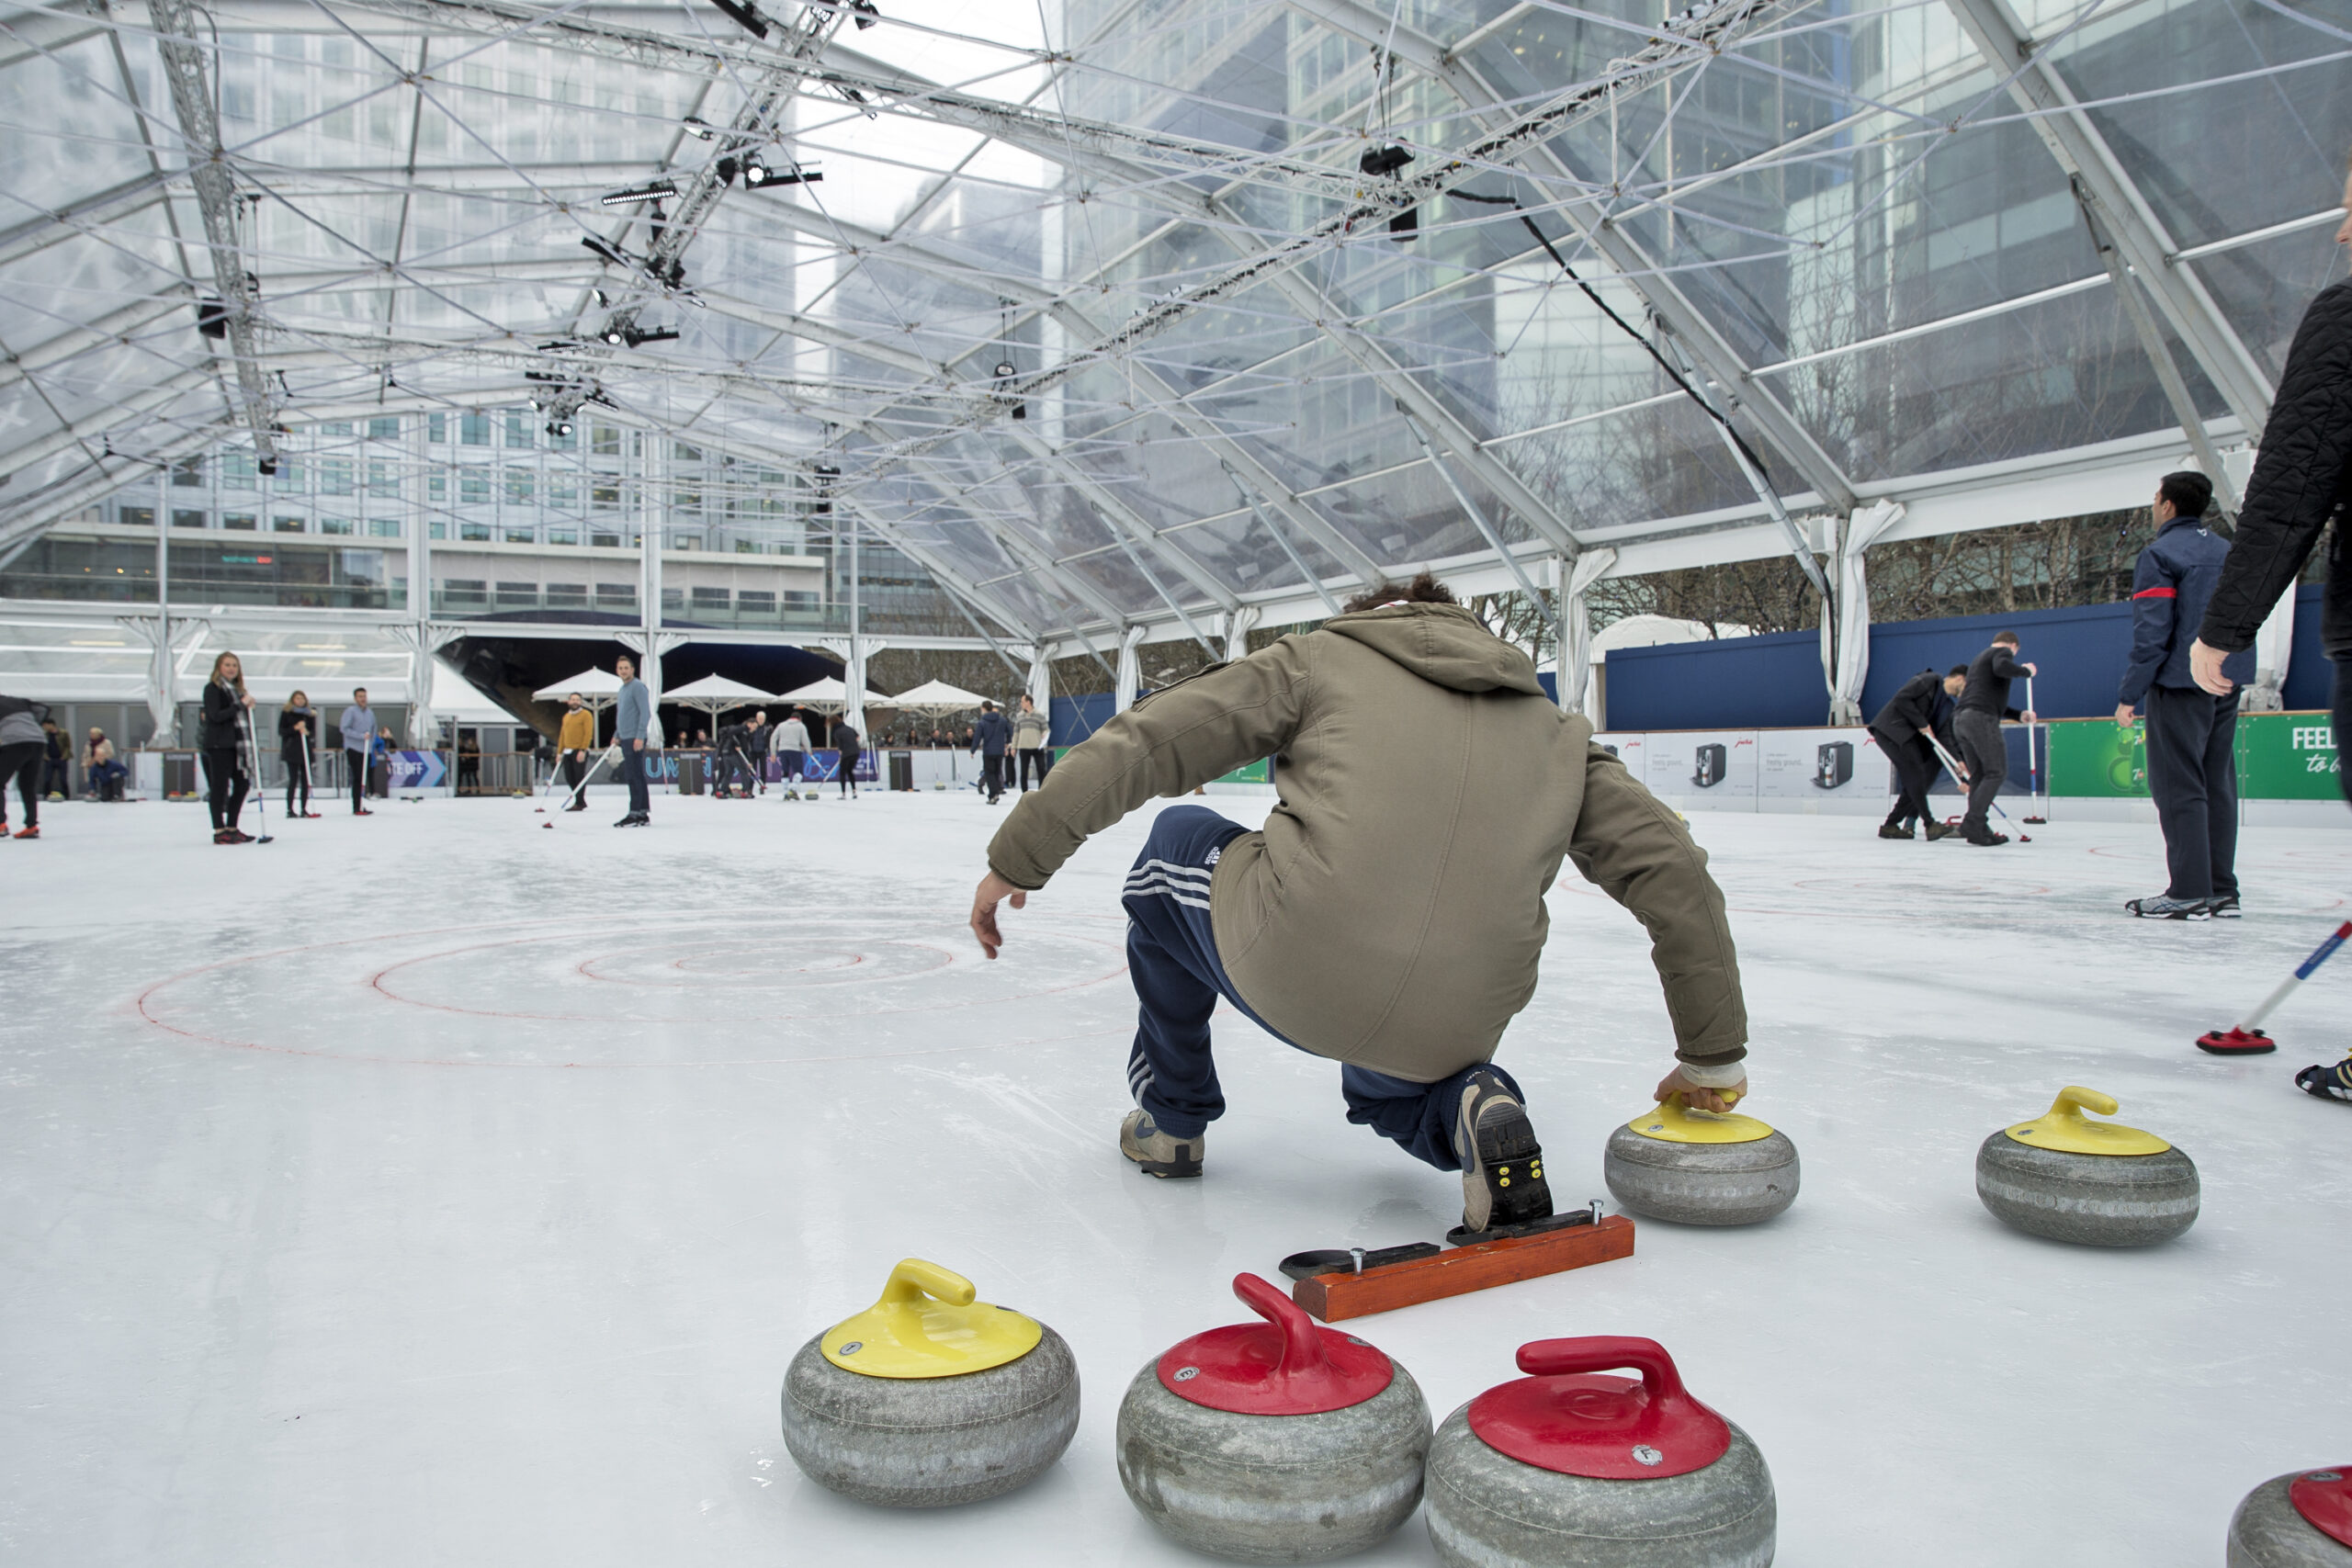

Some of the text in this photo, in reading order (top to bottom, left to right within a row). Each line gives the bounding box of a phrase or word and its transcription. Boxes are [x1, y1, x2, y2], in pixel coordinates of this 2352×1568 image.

[2292, 727, 2338, 750] FEEL
[405, 761, 424, 775] OFF
[2305, 753, 2328, 773] to
